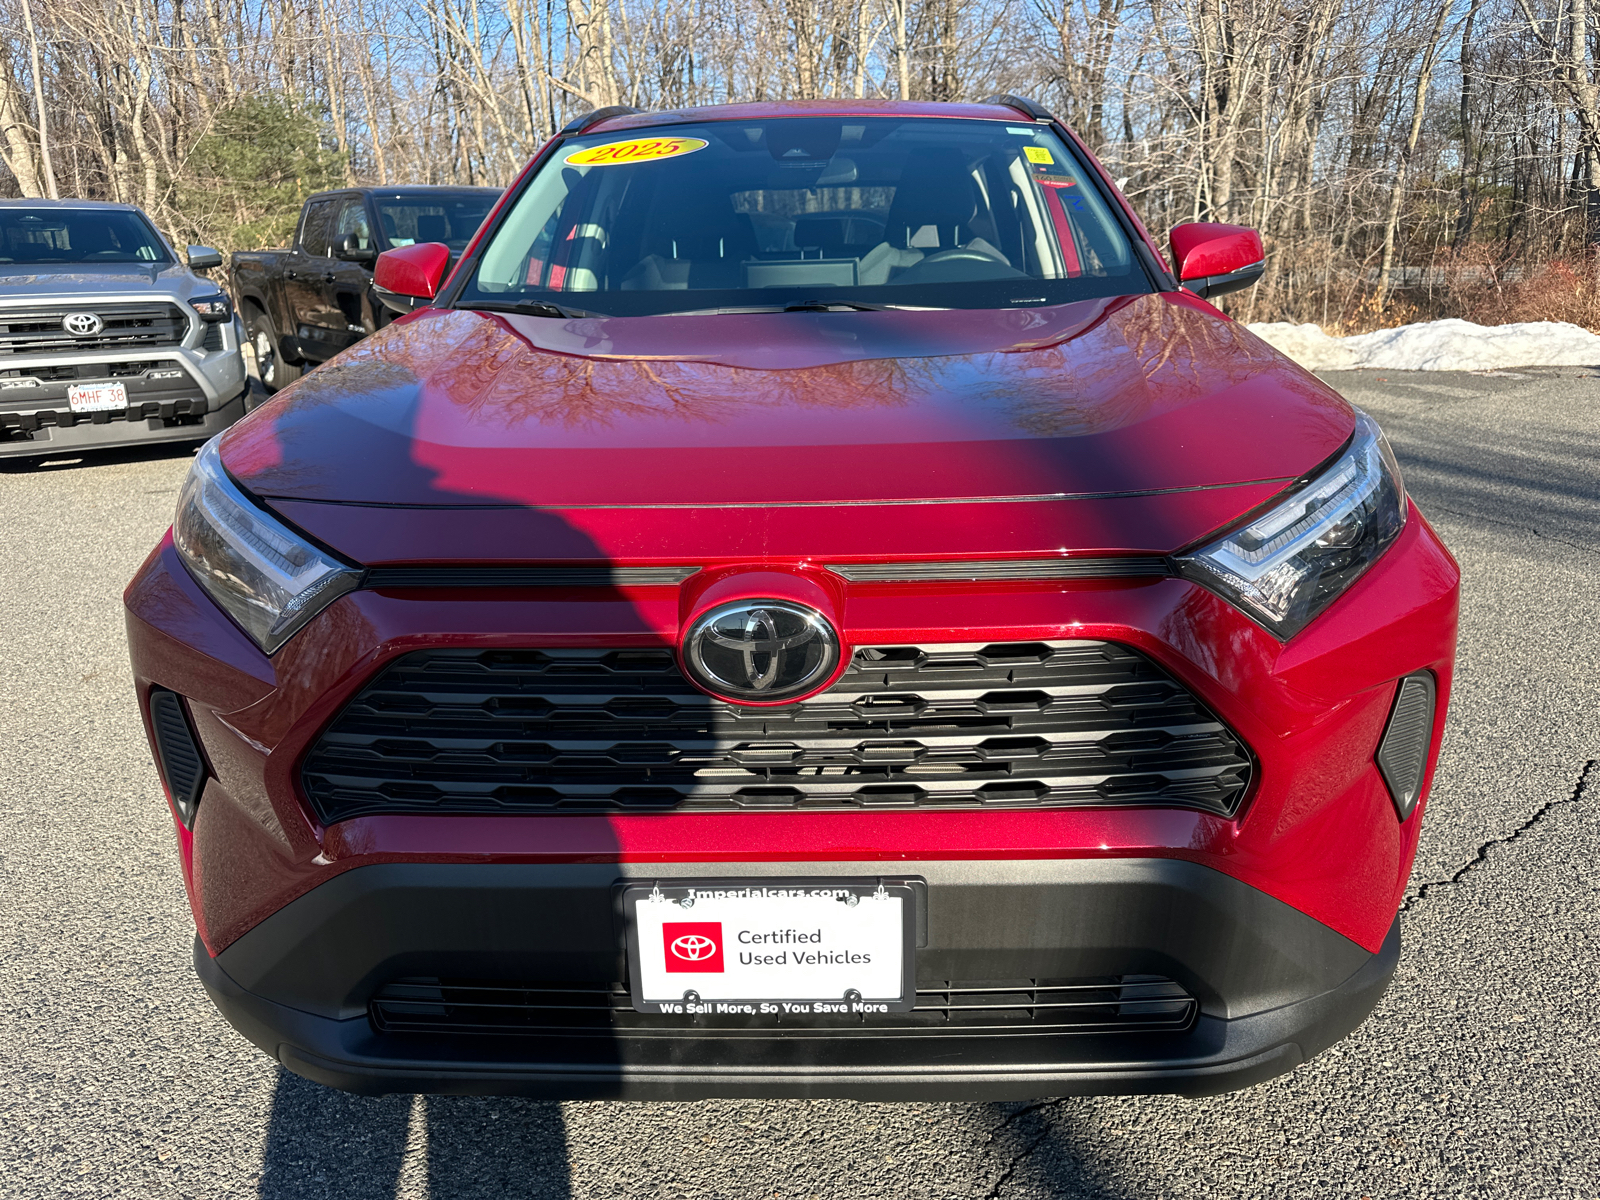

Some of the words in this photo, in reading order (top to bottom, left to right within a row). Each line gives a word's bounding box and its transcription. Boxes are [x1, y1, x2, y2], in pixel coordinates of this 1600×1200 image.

[585, 140, 687, 163] 2025
[71, 389, 102, 405] 6MHF
[108, 388, 125, 402] 38
[687, 887, 850, 900] Imperialcars.com
[737, 929, 822, 945] Certified
[739, 951, 787, 965] Used
[792, 949, 872, 965] Vehicles
[659, 1003, 683, 1014] We
[686, 1003, 712, 1014] Sell
[716, 1003, 757, 1016] More,
[760, 1002, 779, 1014] So
[782, 1002, 810, 1014] You
[813, 1002, 849, 1014] Save
[852, 1002, 888, 1013] More
